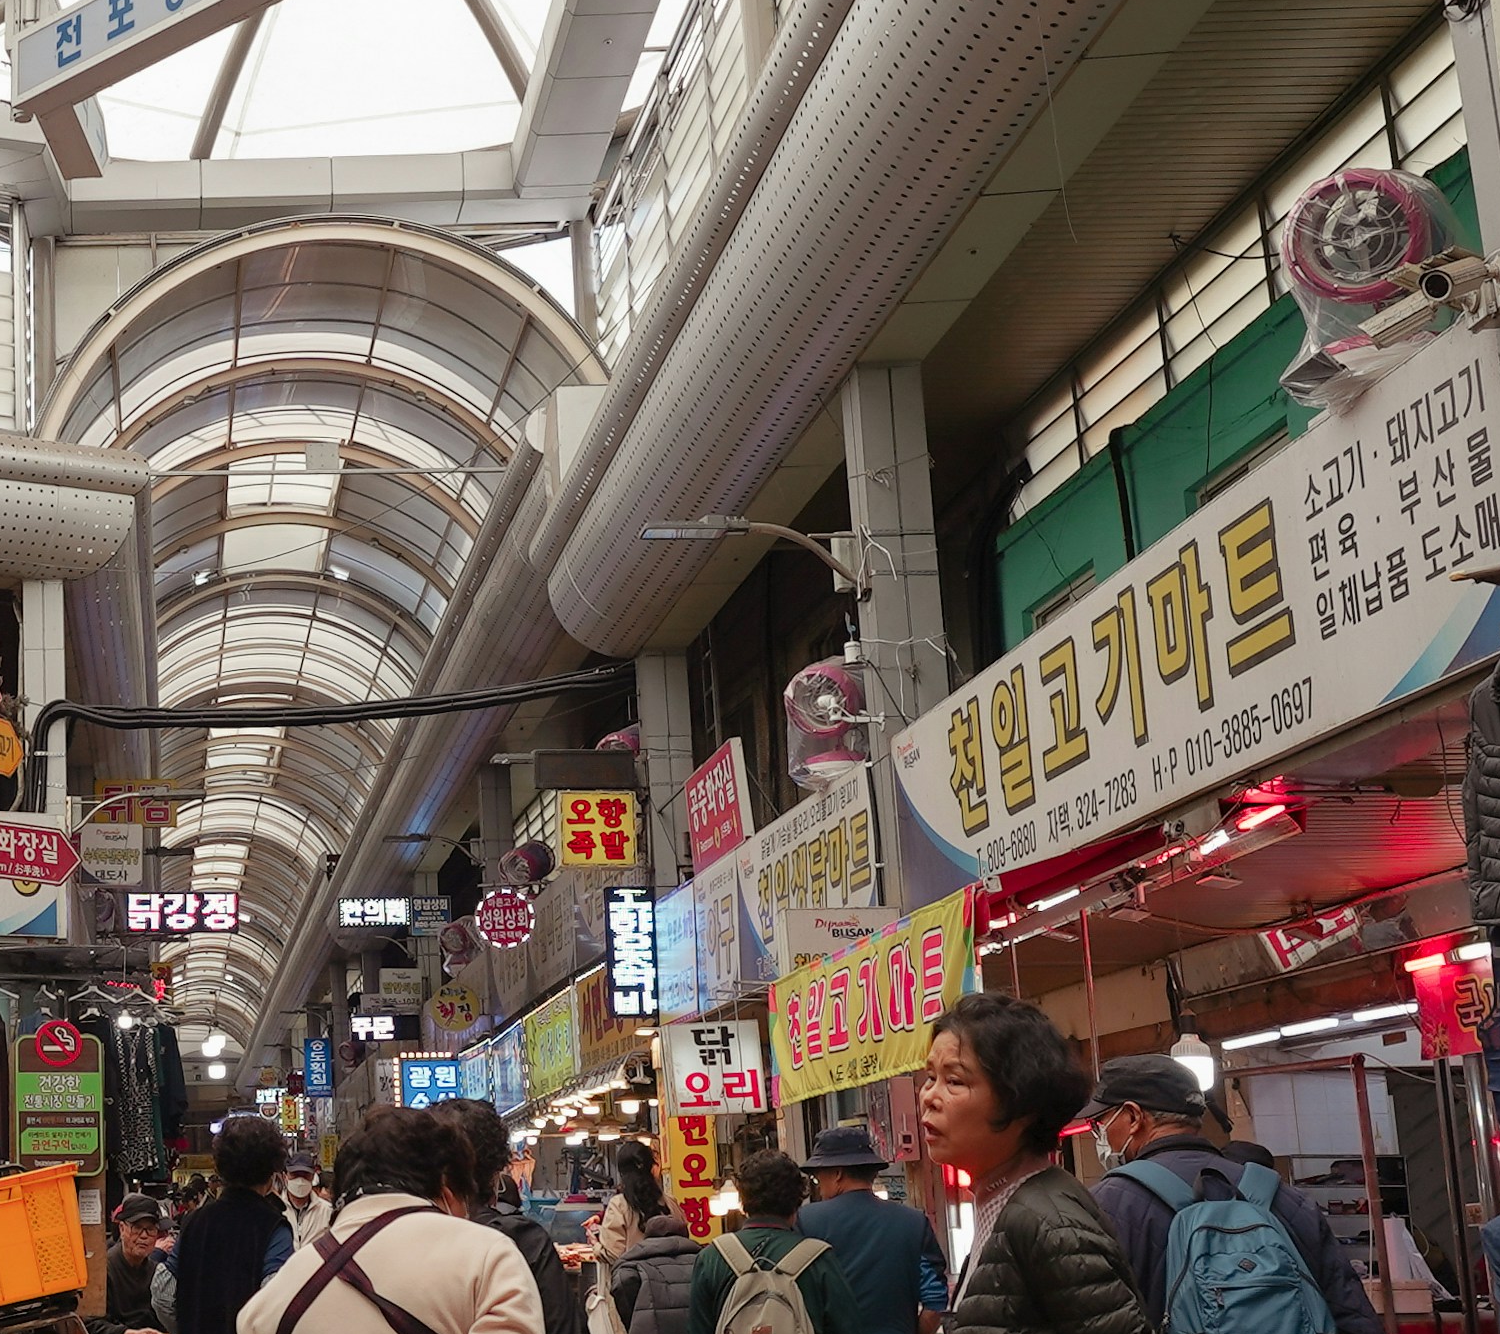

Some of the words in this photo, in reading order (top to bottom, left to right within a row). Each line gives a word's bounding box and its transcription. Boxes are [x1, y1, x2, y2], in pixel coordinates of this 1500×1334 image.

[1304, 440, 1365, 522] 소고기
[1386, 357, 1486, 467] 돼지고기
[1316, 547, 1410, 641] 일체납품
[947, 496, 1296, 837] 천일고기마트
[688, 754, 736, 833] 공중화장실
[987, 821, 1038, 872] 809-6880
[1076, 770, 1138, 830] 324-7283
[1185, 676, 1316, 777] 010-3885-0697
[566, 798, 628, 828] 오향
[567, 830, 630, 860] 족발
[95, 870, 129, 882] 대도사
[128, 892, 239, 931] 닭강정
[481, 909, 529, 930] 성원상회
[832, 927, 875, 938] BUSAN
[787, 925, 946, 1070] 천일고기마트
[691, 1026, 735, 1066] 닭
[38, 1075, 81, 1093] 건강한
[409, 1065, 456, 1088] 광원
[680, 1069, 761, 1109] 오리
[24, 1095, 63, 1109] 전통시장
[66, 1095, 96, 1109] 만들기
